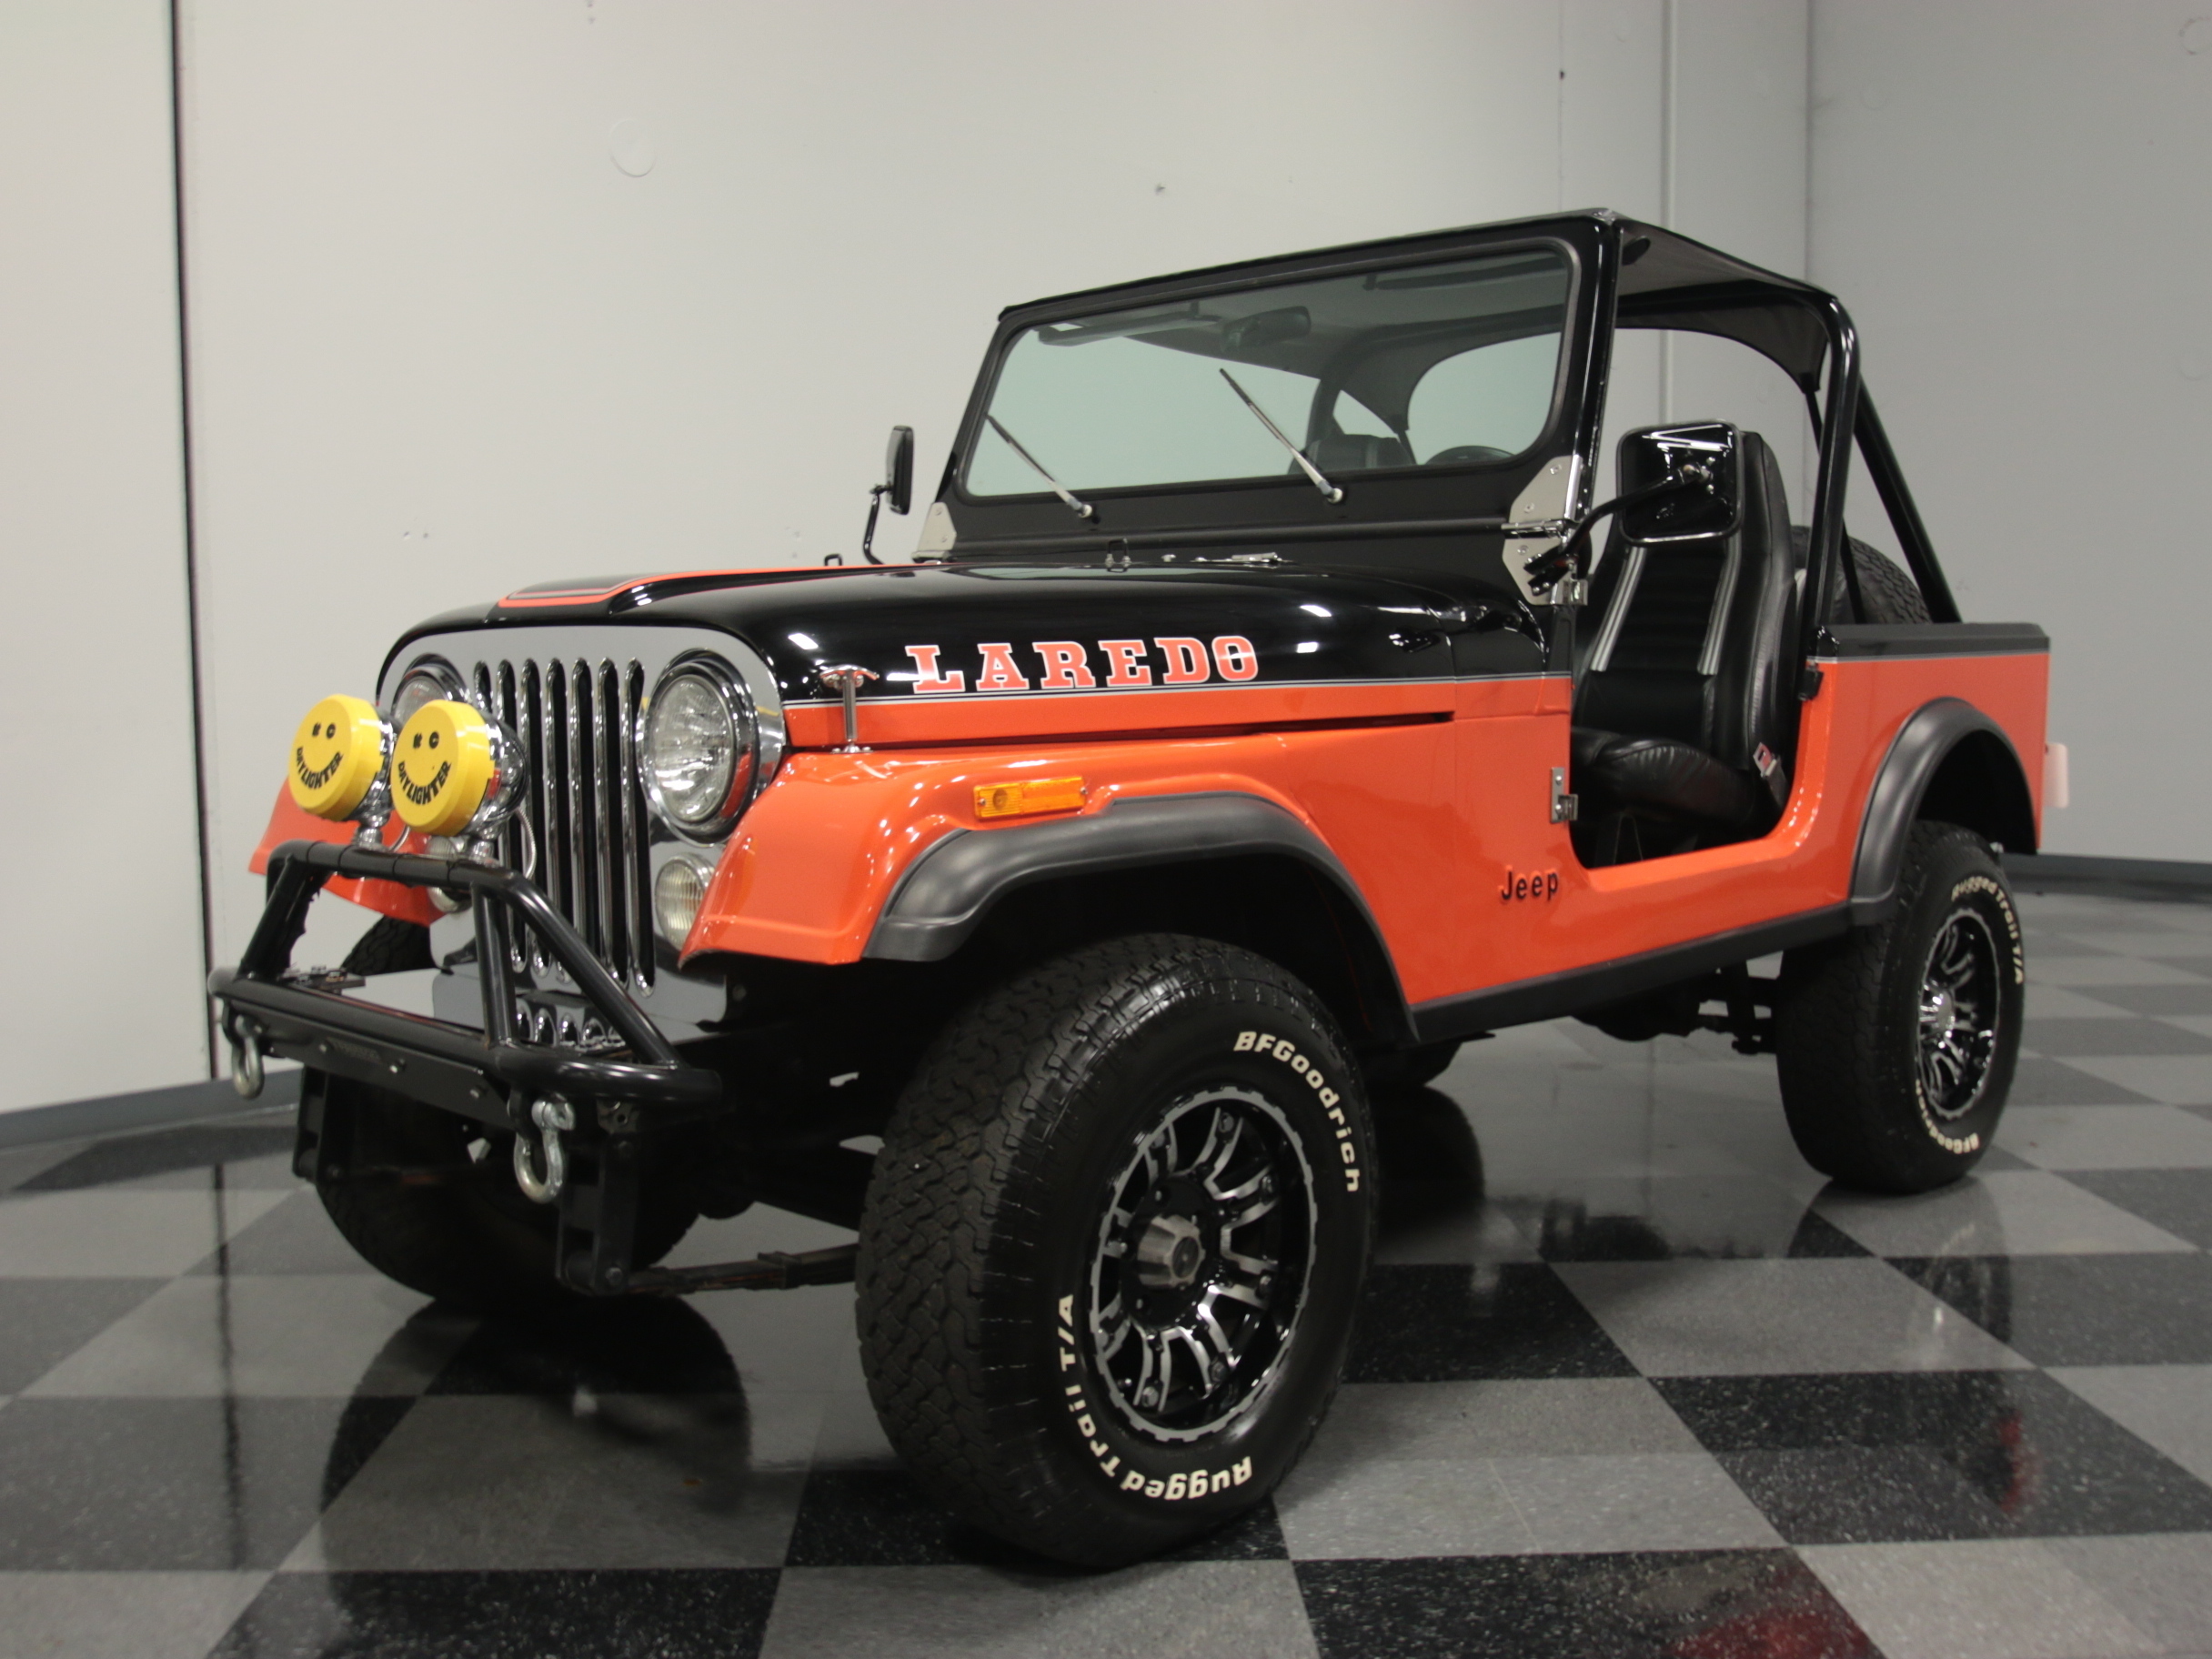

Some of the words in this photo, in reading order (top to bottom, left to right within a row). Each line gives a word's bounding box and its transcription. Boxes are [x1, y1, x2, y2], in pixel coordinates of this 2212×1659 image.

[905, 636, 1259, 694] LAREDO
[296, 745, 344, 789] DAYLIGHTER
[397, 760, 452, 807] DAYLIGHTER
[1501, 870, 1559, 901] Jeep
[1233, 1031, 1361, 1192] BFGoodrich
[1058, 1294, 1076, 1372] T/A
